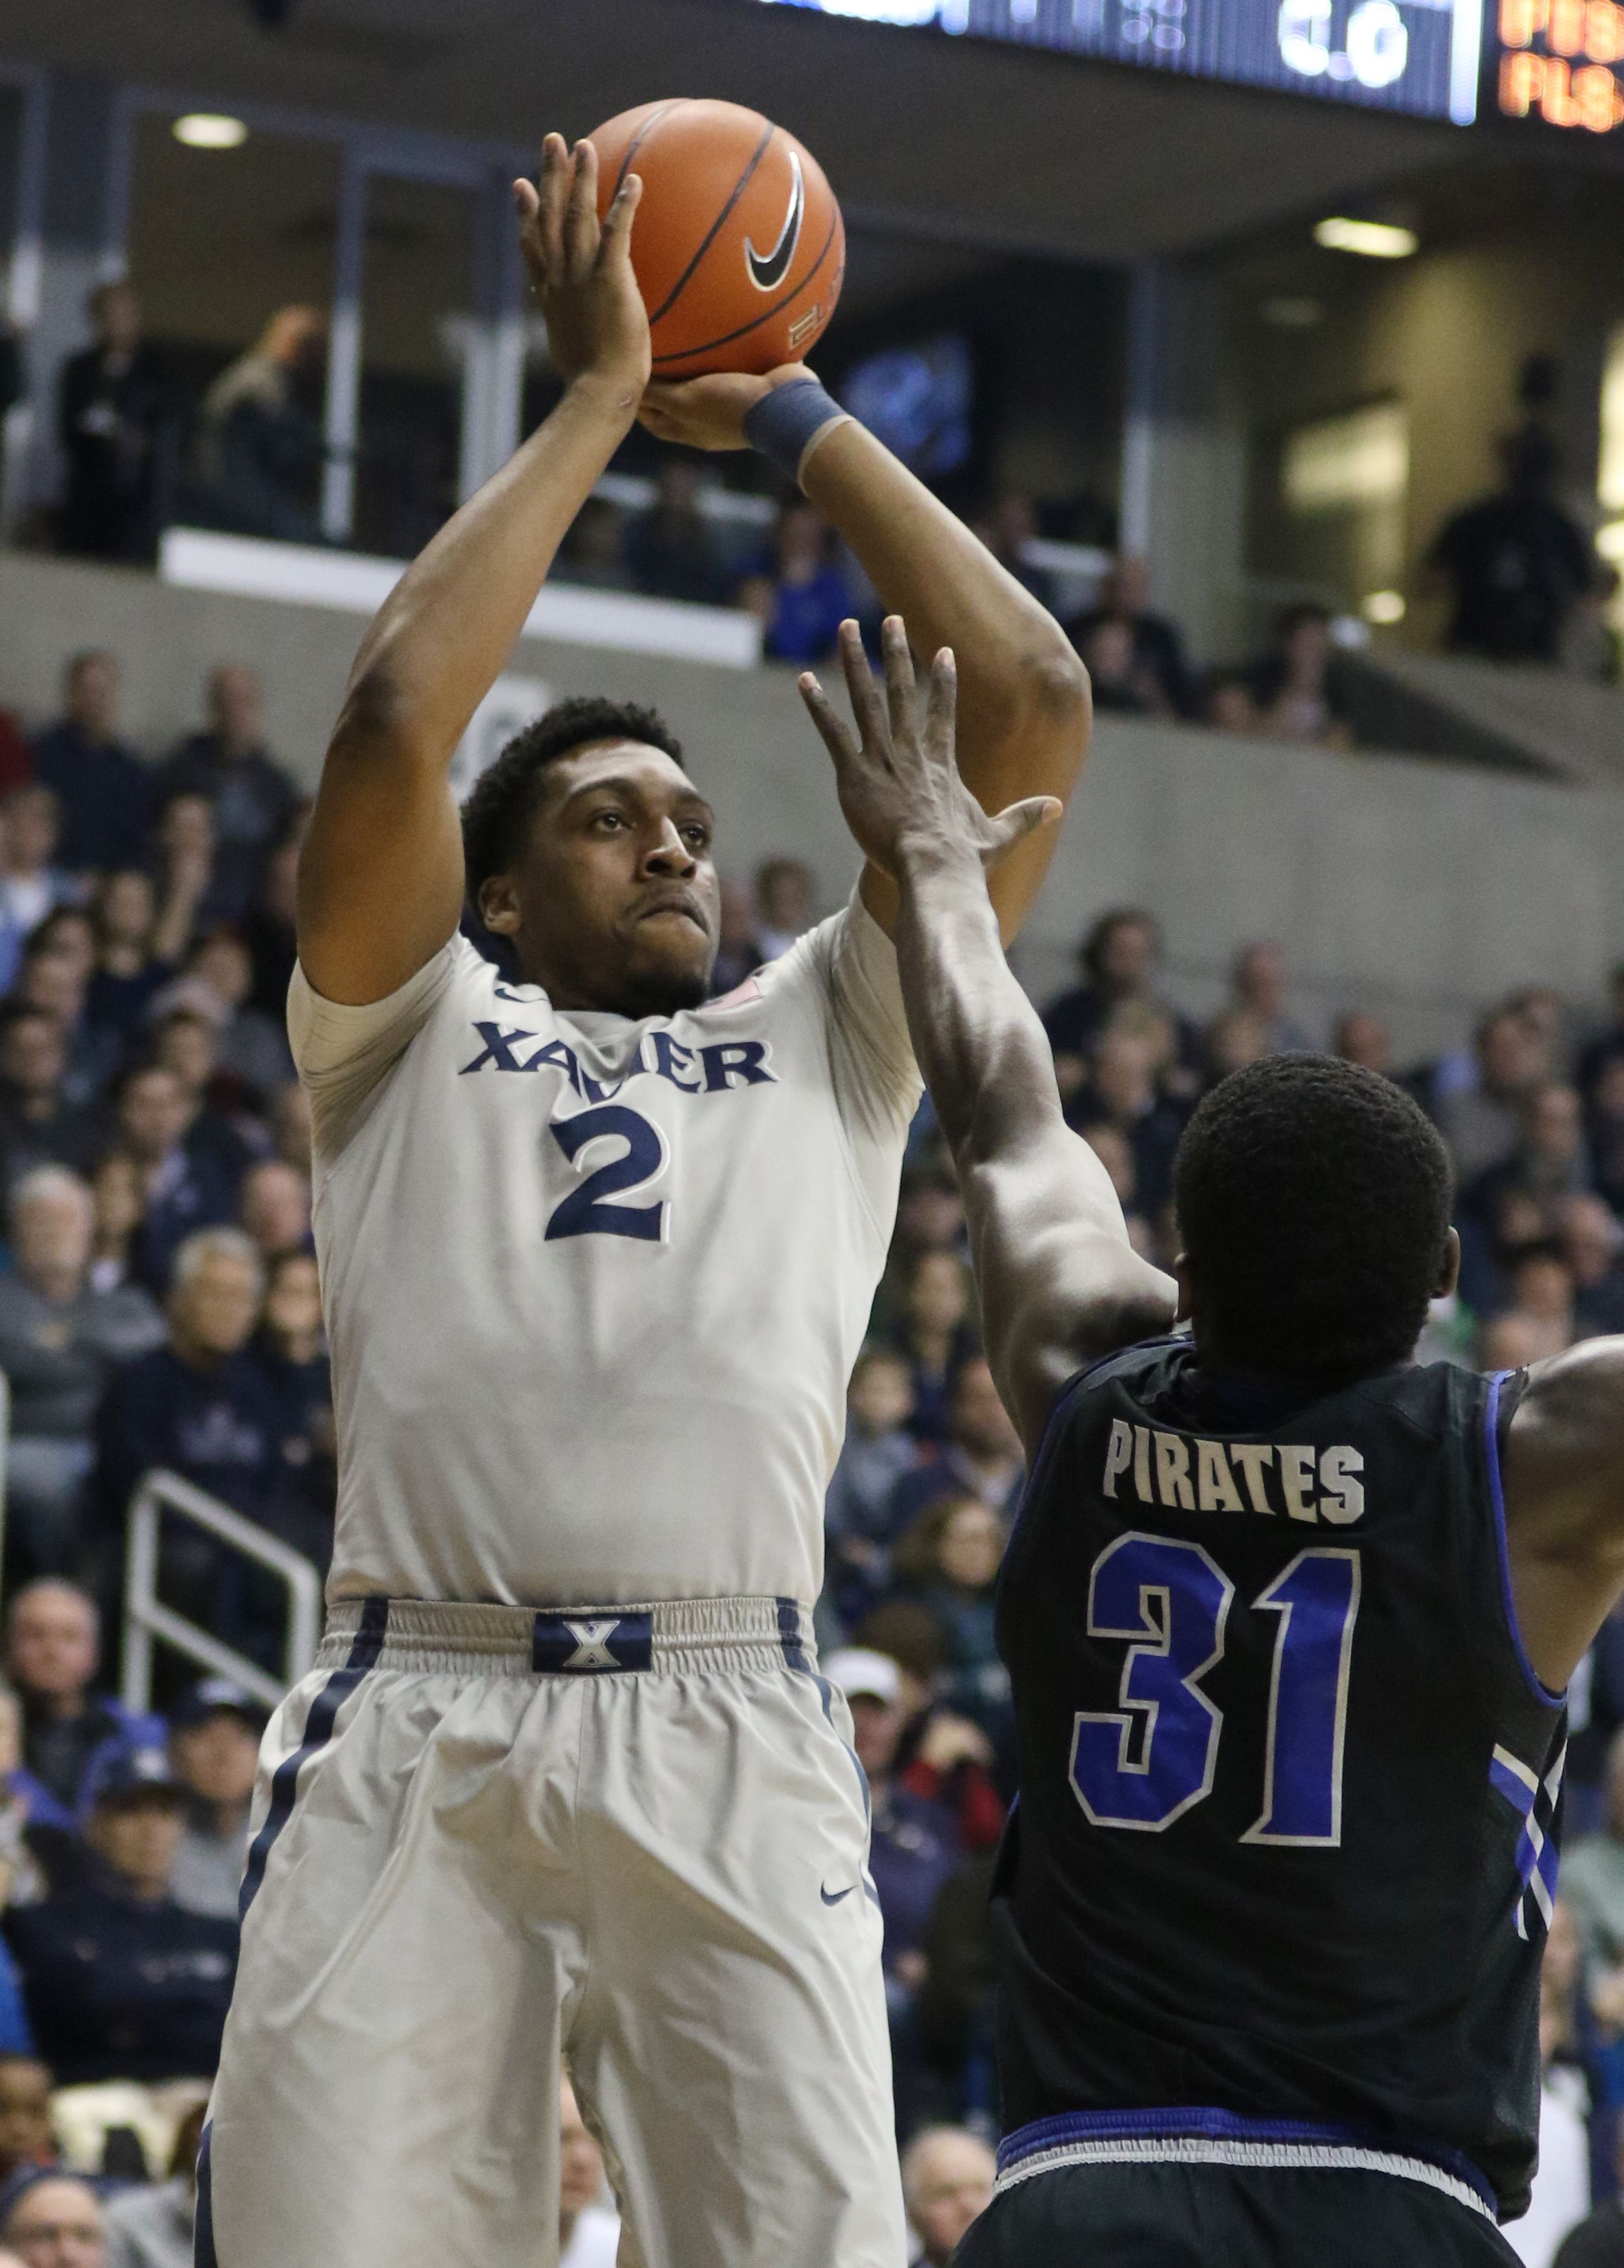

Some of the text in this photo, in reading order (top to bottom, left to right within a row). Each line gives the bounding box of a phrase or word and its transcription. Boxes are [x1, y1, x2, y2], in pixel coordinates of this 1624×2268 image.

[544, 1105, 672, 1244] 2
[1103, 1418, 1365, 1525] PIRATES
[1068, 1531, 1361, 1847] 31
